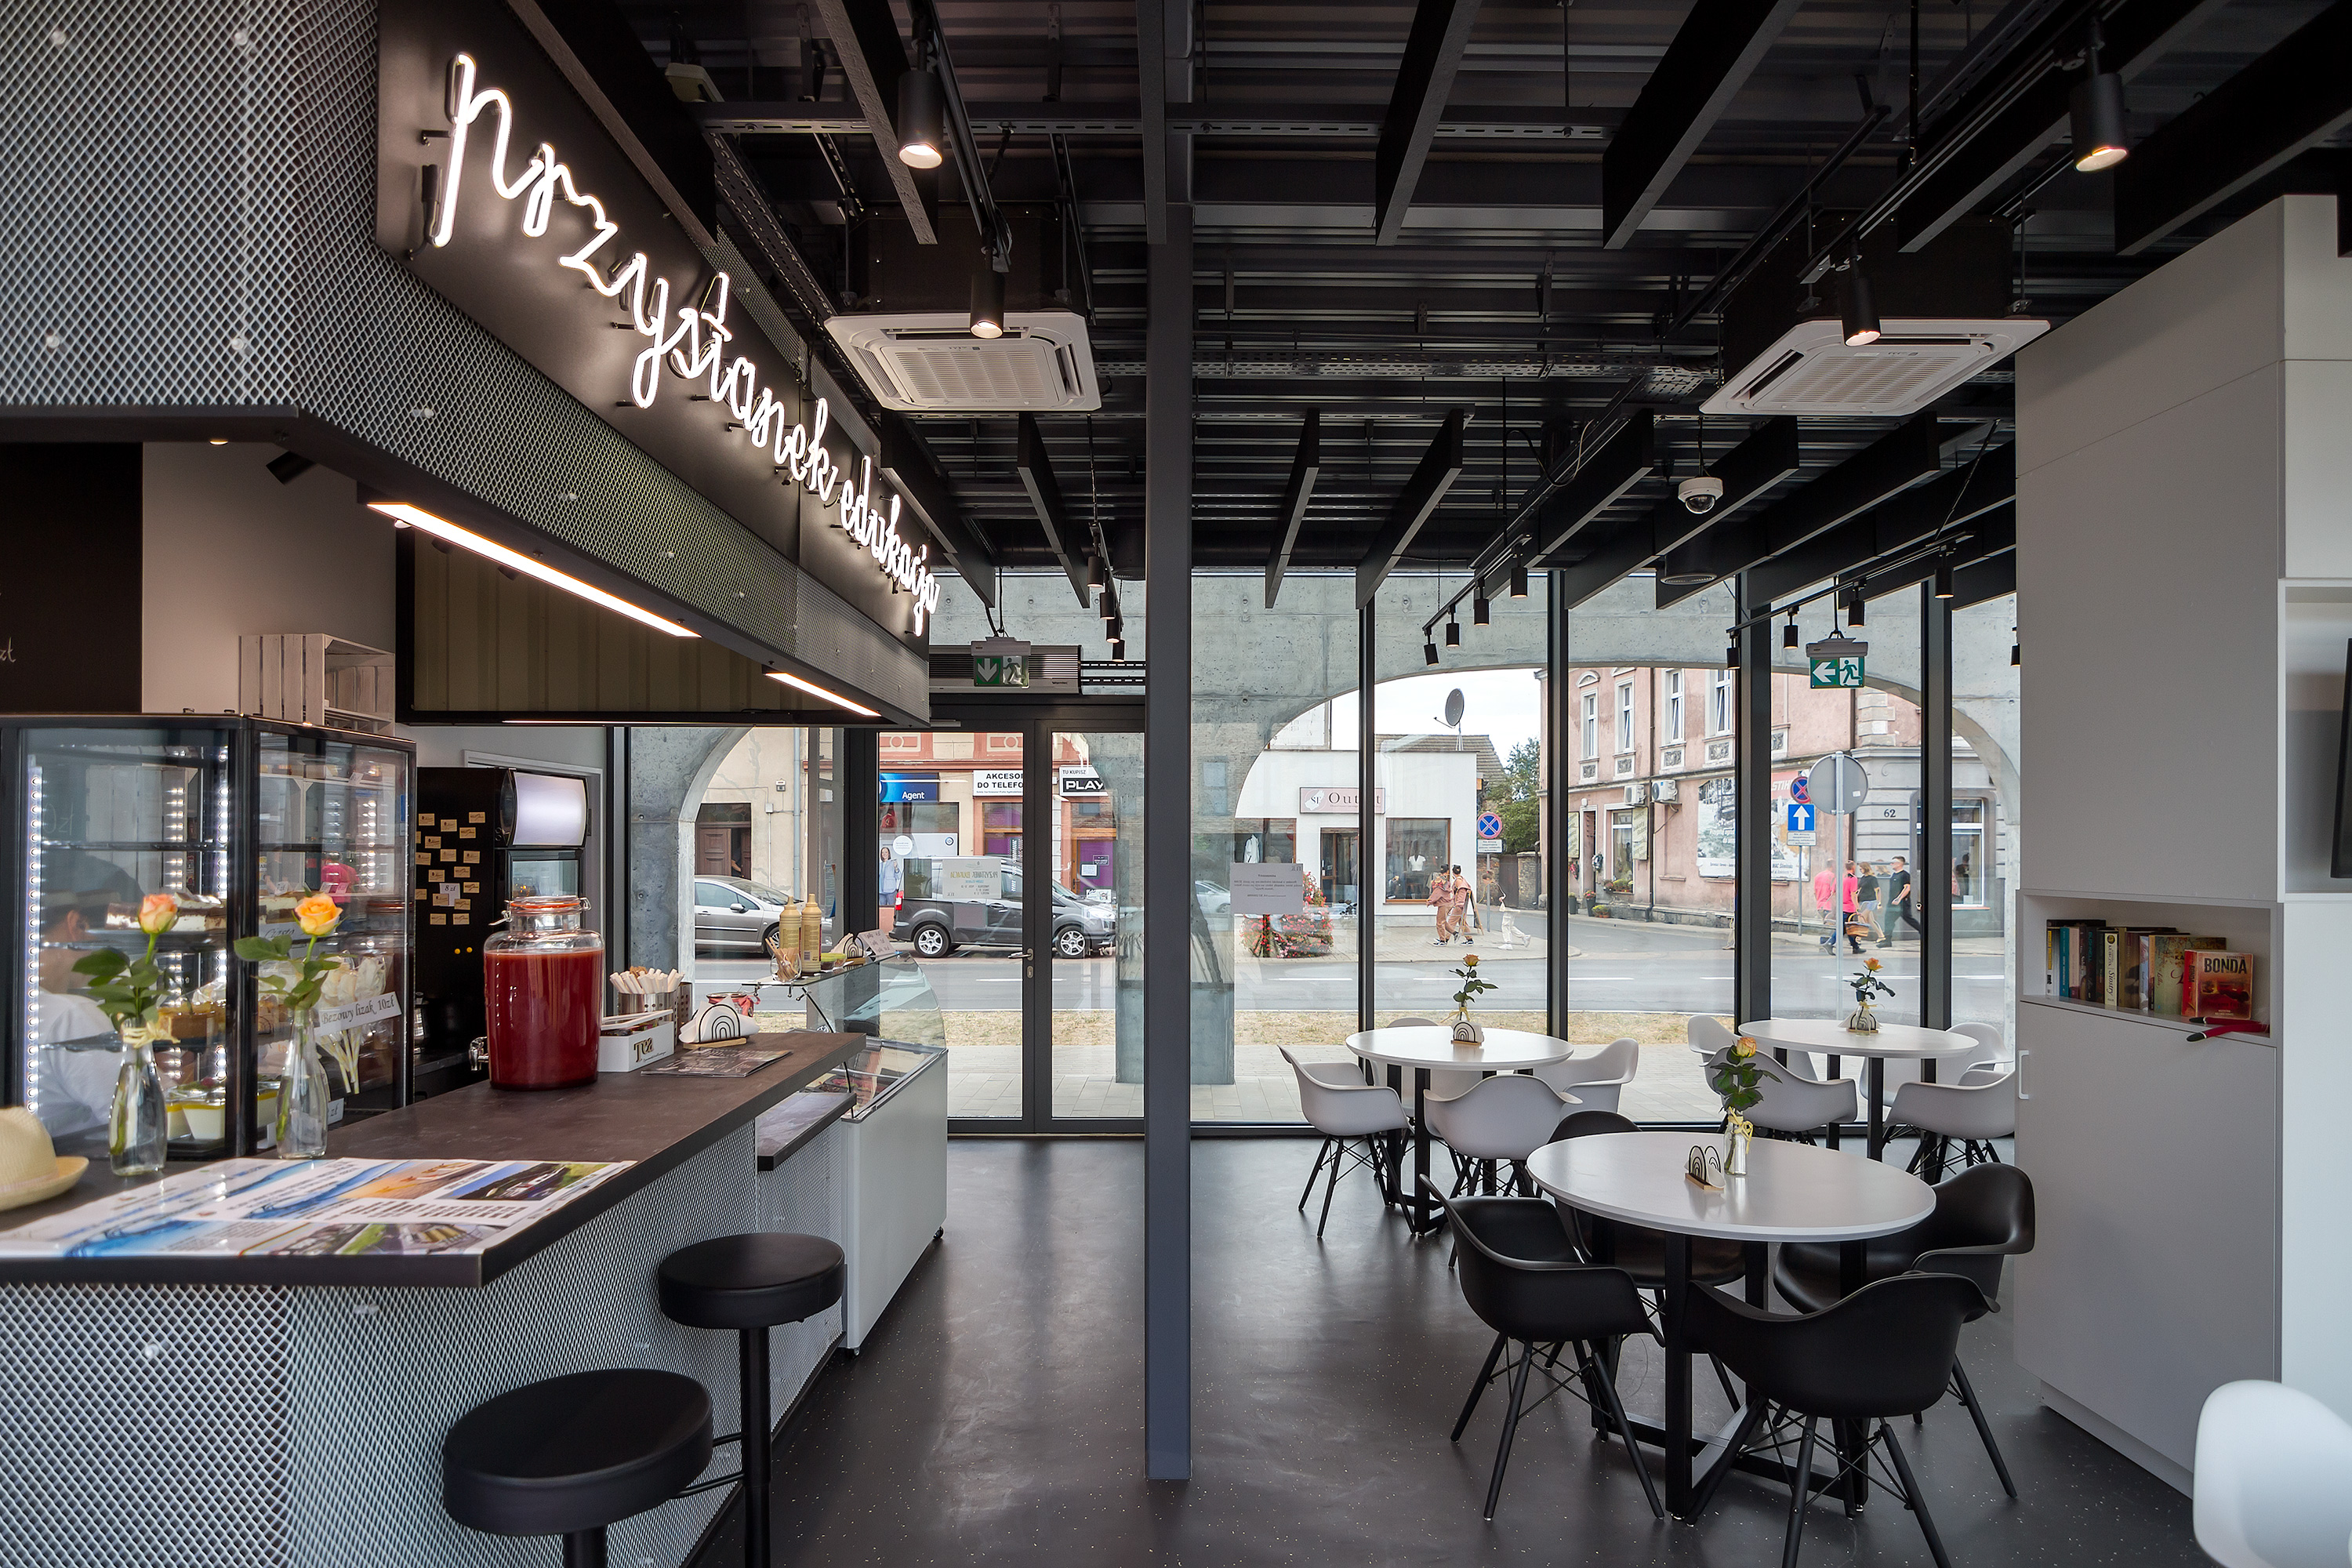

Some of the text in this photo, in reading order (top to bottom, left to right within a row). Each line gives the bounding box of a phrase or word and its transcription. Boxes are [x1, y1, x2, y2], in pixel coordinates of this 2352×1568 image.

[1065, 780, 1105, 790] PLAY
[1772, 779, 1794, 791] STIH
[902, 790, 925, 800] Agent
[1328, 792, 1381, 804] Outt
[1883, 808, 1896, 818] 62
[2204, 957, 2248, 974] BONDA
[2106, 970, 2116, 996] Siostry
